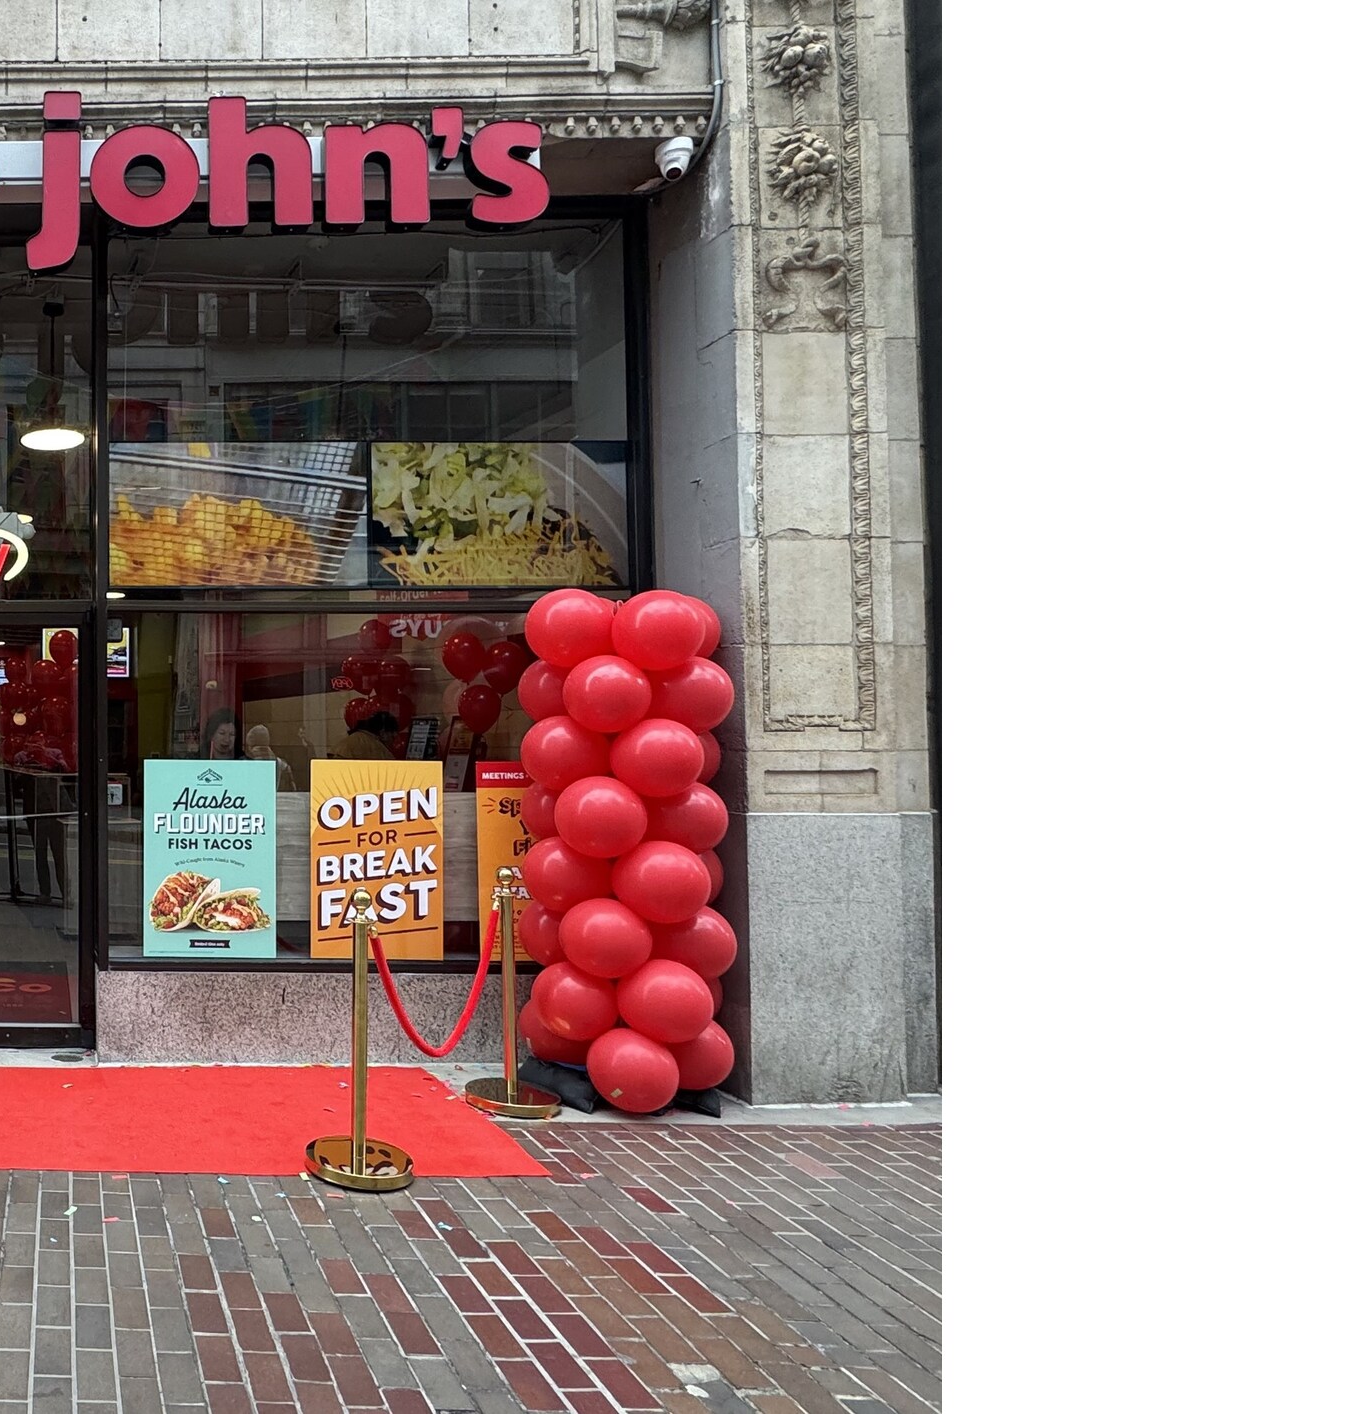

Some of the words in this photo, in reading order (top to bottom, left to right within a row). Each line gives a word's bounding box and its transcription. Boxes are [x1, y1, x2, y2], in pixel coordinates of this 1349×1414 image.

[24, 91, 550, 274] john's
[482, 772, 525, 780] MEETINGS
[173, 787, 248, 812] Alaska
[318, 786, 439, 830] OPEN
[154, 812, 266, 835] FLOUNDER
[168, 838, 198, 850] FISH
[203, 838, 253, 850] TACOS
[357, 829, 398, 847] FOR
[317, 844, 438, 886] BREAK
